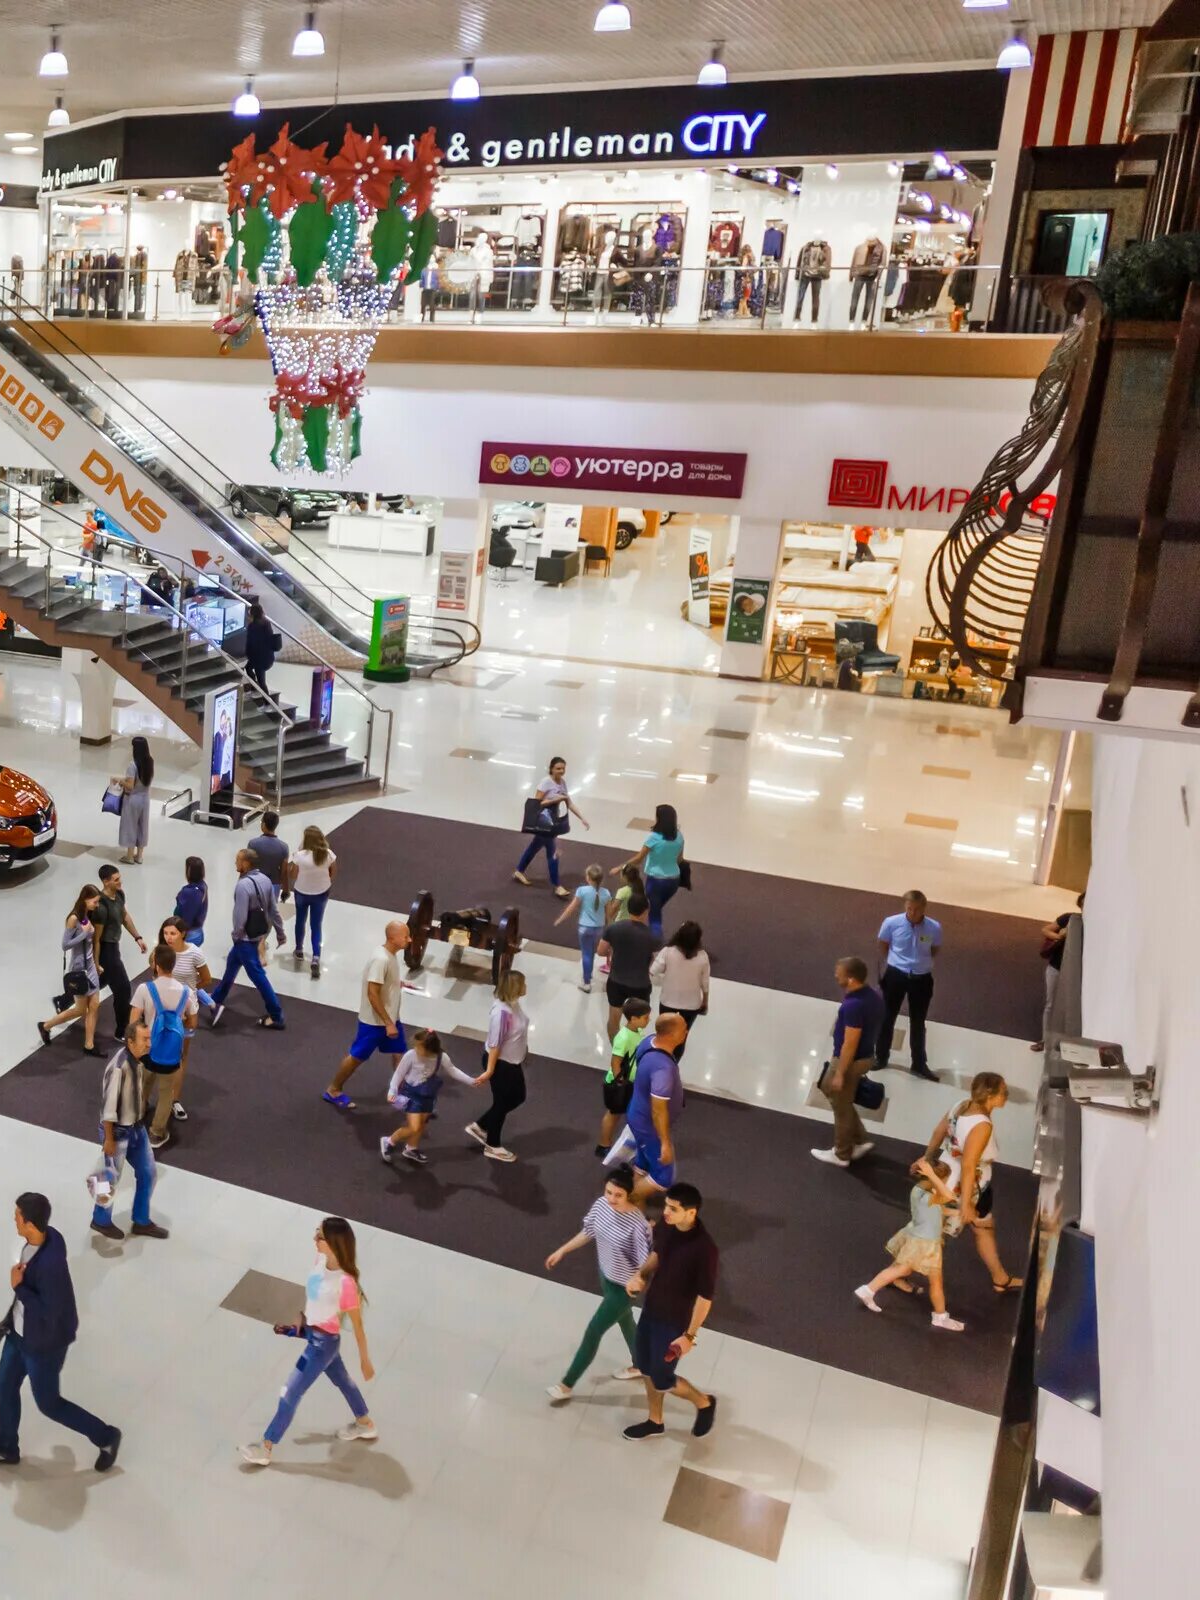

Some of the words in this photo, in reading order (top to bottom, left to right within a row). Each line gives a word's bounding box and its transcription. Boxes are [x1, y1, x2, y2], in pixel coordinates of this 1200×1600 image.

[446, 132, 470, 162] &
[481, 126, 673, 168] gentleman
[682, 113, 766, 156] CITY
[61, 163, 98, 190] gentleman
[99, 157, 117, 183] CITY
[574, 457, 684, 482] уютерра
[688, 471, 706, 480] для
[707, 473, 732, 481] дома
[690, 462, 724, 471] товары
[80, 448, 167, 533] DNS
[887, 485, 971, 513] МИР
[214, 555, 225, 566] 2
[223, 563, 254, 593] ЭТЖ
